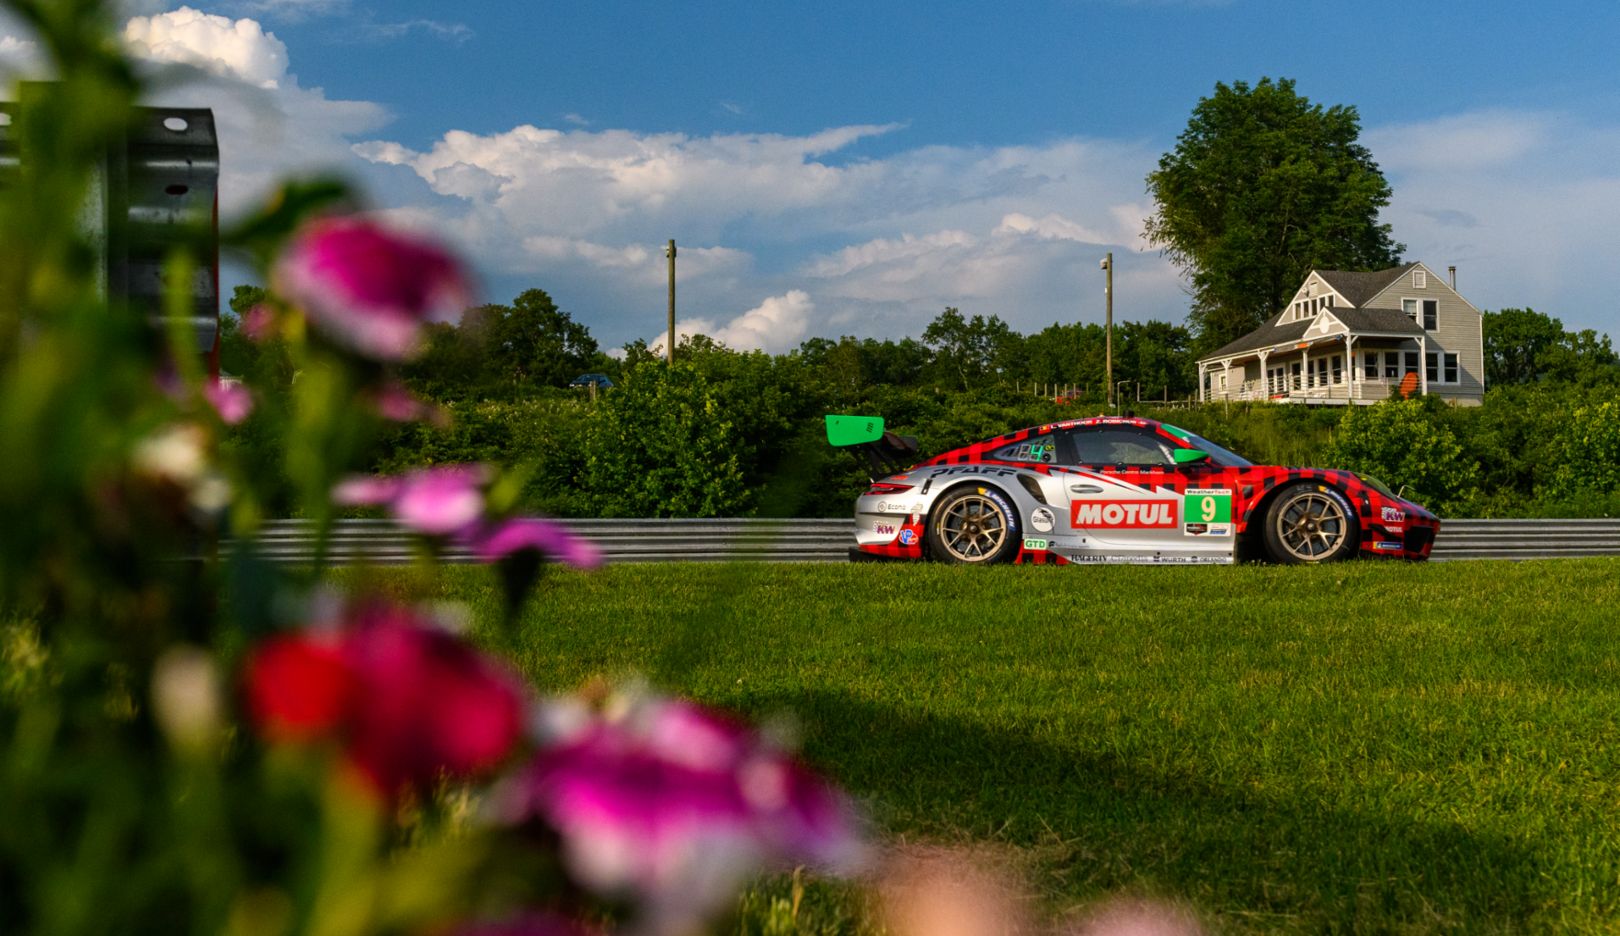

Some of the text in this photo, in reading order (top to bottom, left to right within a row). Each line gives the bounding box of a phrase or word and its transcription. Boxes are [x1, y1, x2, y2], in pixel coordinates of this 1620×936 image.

[931, 465, 1017, 478] PFAFF
[1076, 503, 1173, 525] MOTUL
[1201, 496, 1216, 522] 9
[1386, 511, 1404, 521] KW
[877, 525, 895, 534] KW
[1025, 540, 1046, 548] GTD
[1071, 554, 1107, 562] HAGERTY
